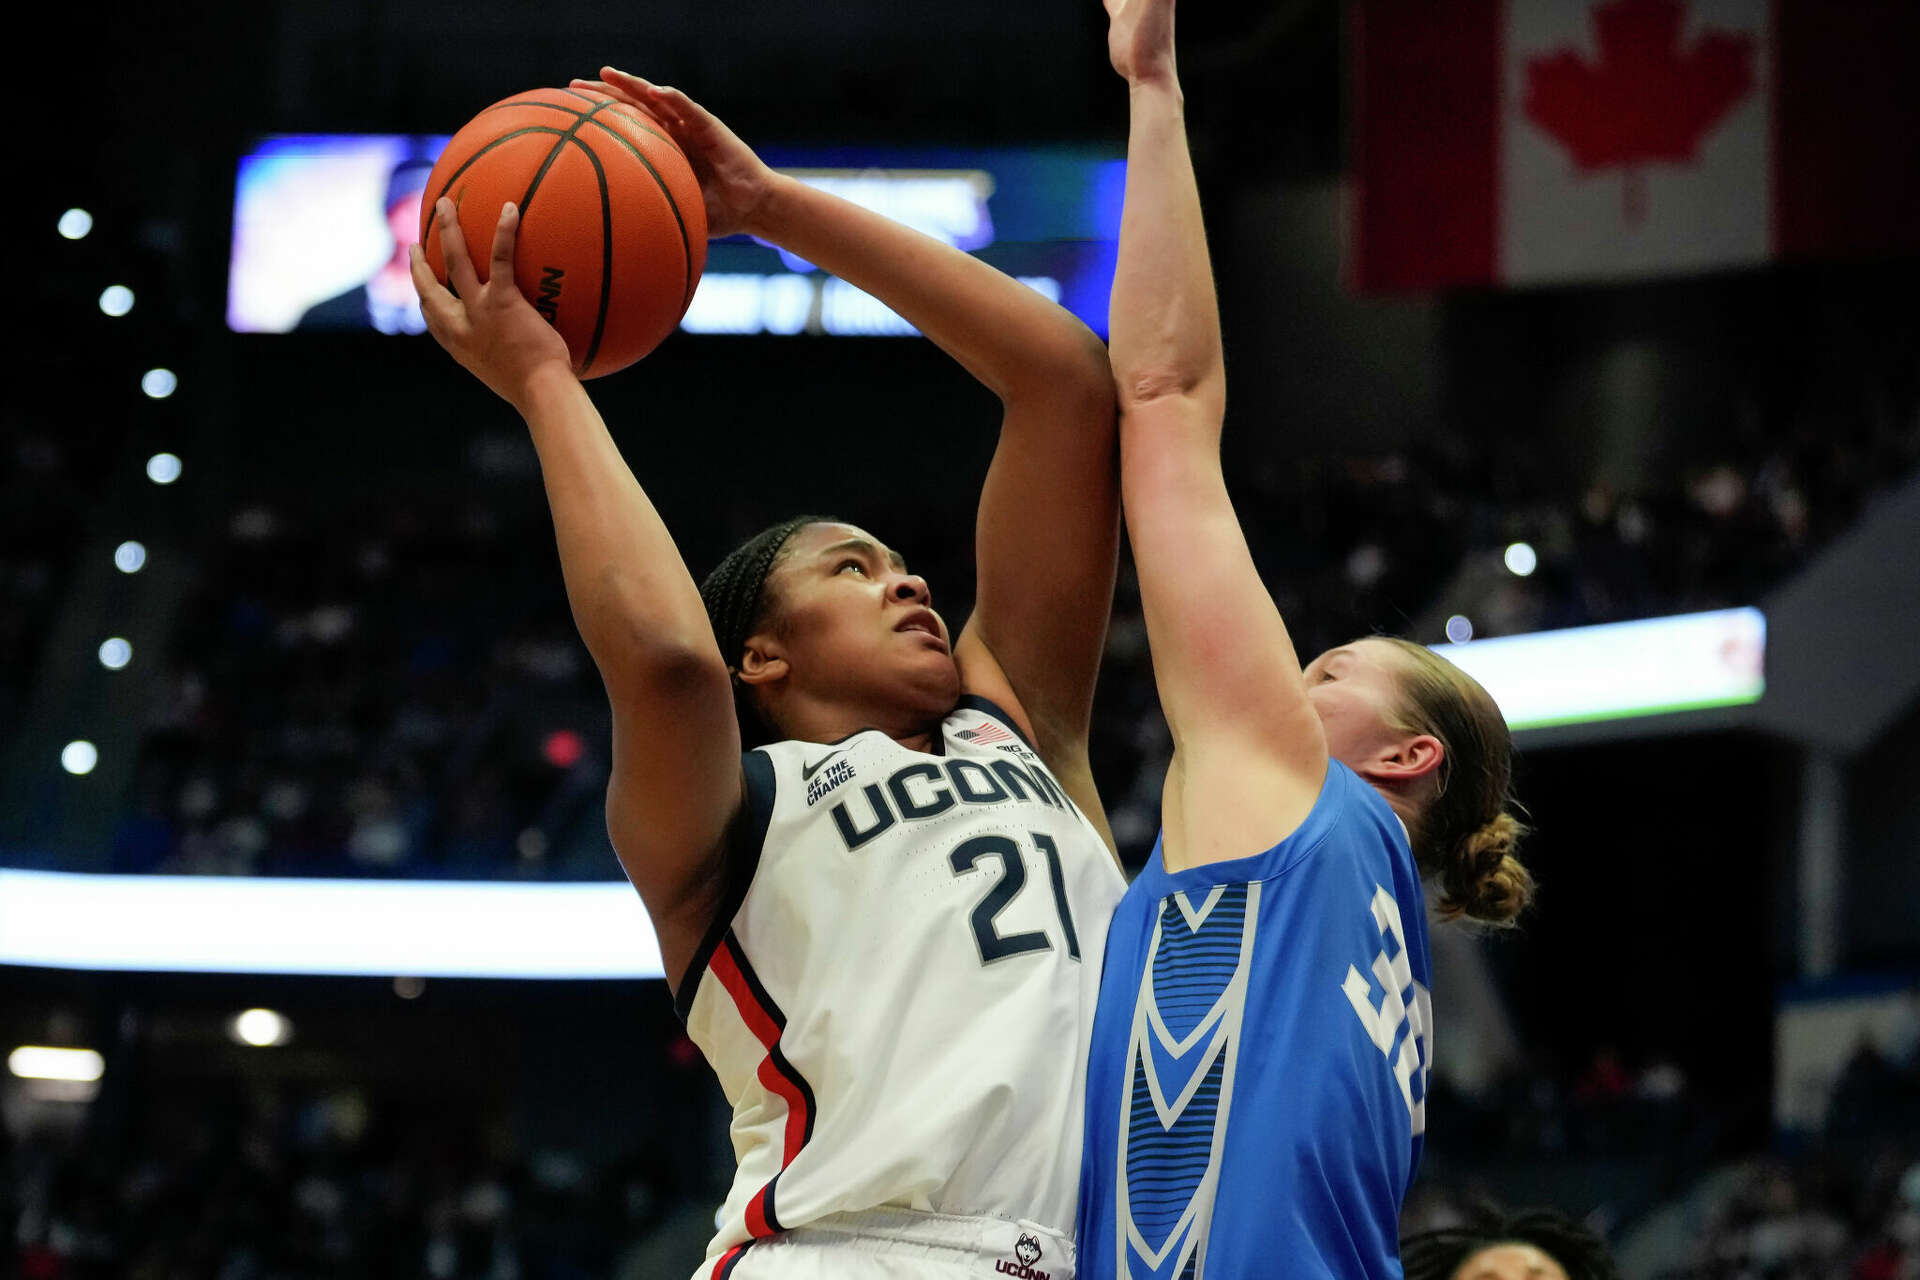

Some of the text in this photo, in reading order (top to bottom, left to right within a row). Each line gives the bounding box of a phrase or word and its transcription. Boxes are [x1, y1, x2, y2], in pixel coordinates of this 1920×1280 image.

[807, 758, 849, 794] BE THE
[807, 766, 857, 806] CHANGE
[947, 830, 1082, 967] 21
[995, 1259, 1051, 1280] UCONN
